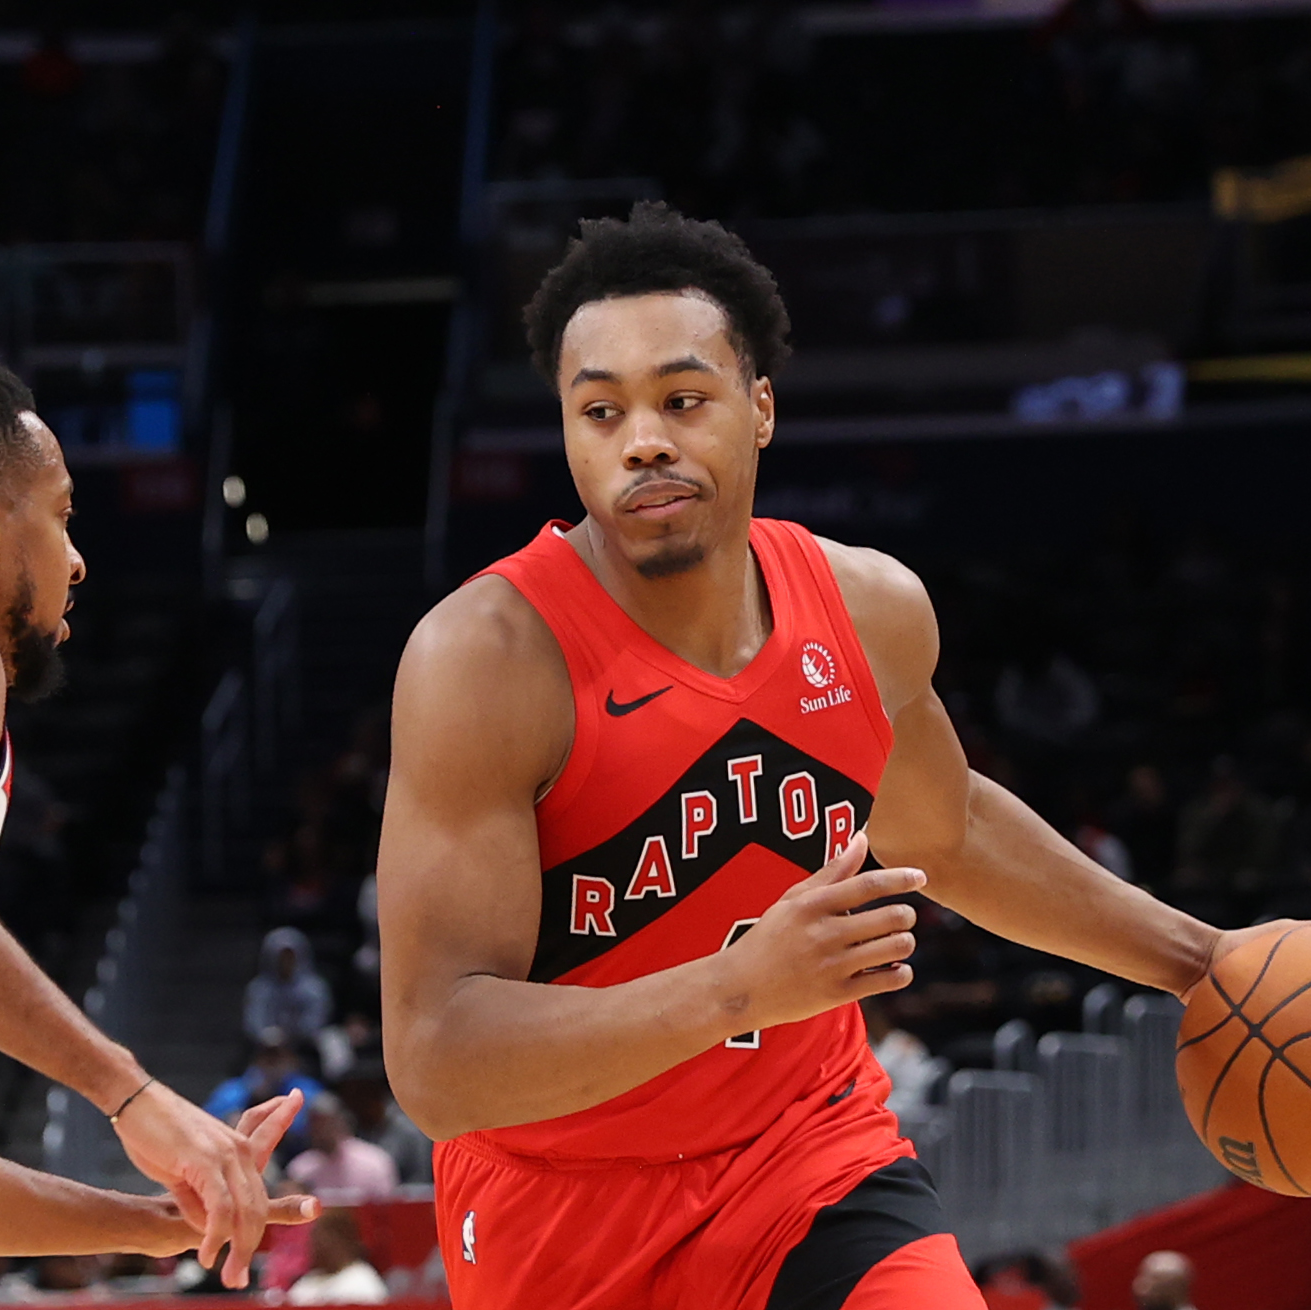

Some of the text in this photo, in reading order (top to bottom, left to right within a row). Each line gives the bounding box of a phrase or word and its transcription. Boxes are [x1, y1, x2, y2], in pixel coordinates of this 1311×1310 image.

[800, 684, 852, 714] Sun Life
[570, 754, 868, 937] RAPTOR
